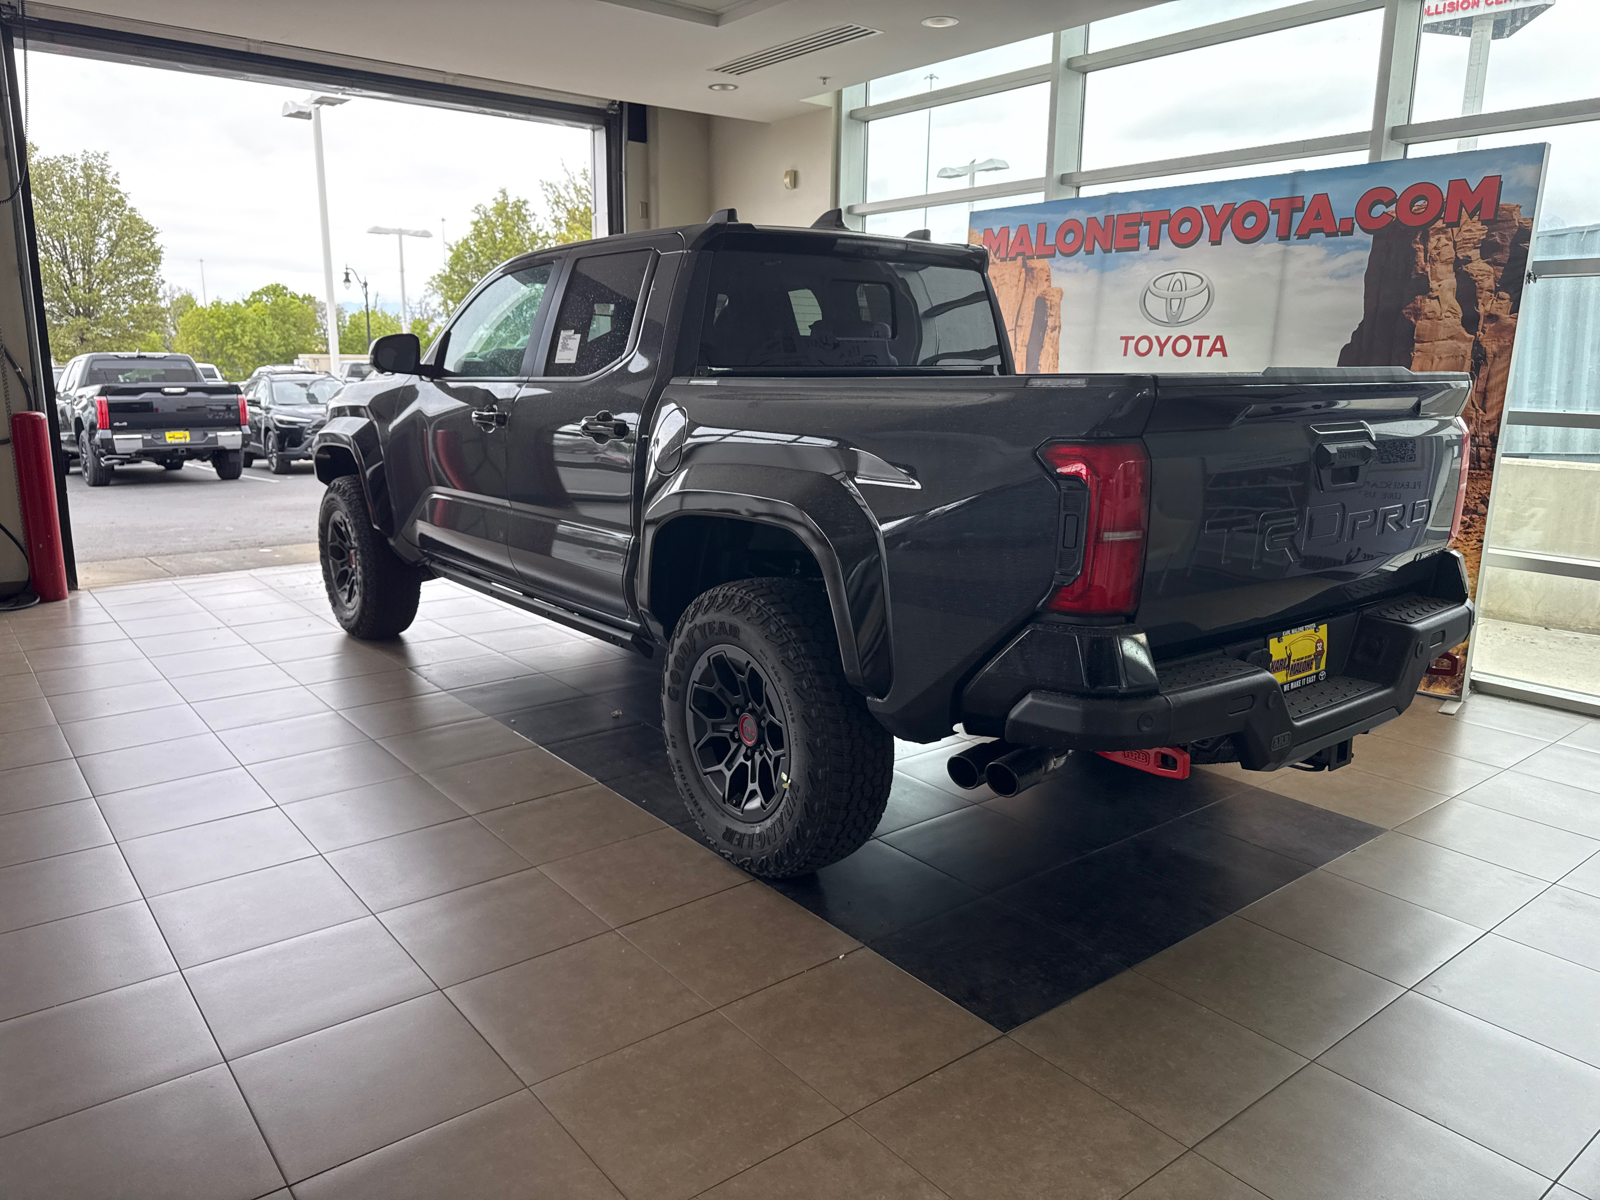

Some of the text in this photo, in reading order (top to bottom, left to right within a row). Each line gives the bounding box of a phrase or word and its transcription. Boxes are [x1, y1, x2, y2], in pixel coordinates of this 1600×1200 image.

[1424, 0, 1480, 16] LLISION
[982, 174, 1503, 262] MALONETOYOTA.COM
[1119, 334, 1229, 359] TOYOTA
[1204, 499, 1432, 569] TRD PRO
[667, 620, 741, 702] GOODYEAR
[1270, 657, 1288, 675] KARL
[1289, 658, 1314, 677] MALONE
[1283, 675, 1316, 692] WE MAKE IT EASY
[1124, 750, 1148, 763] ARB
